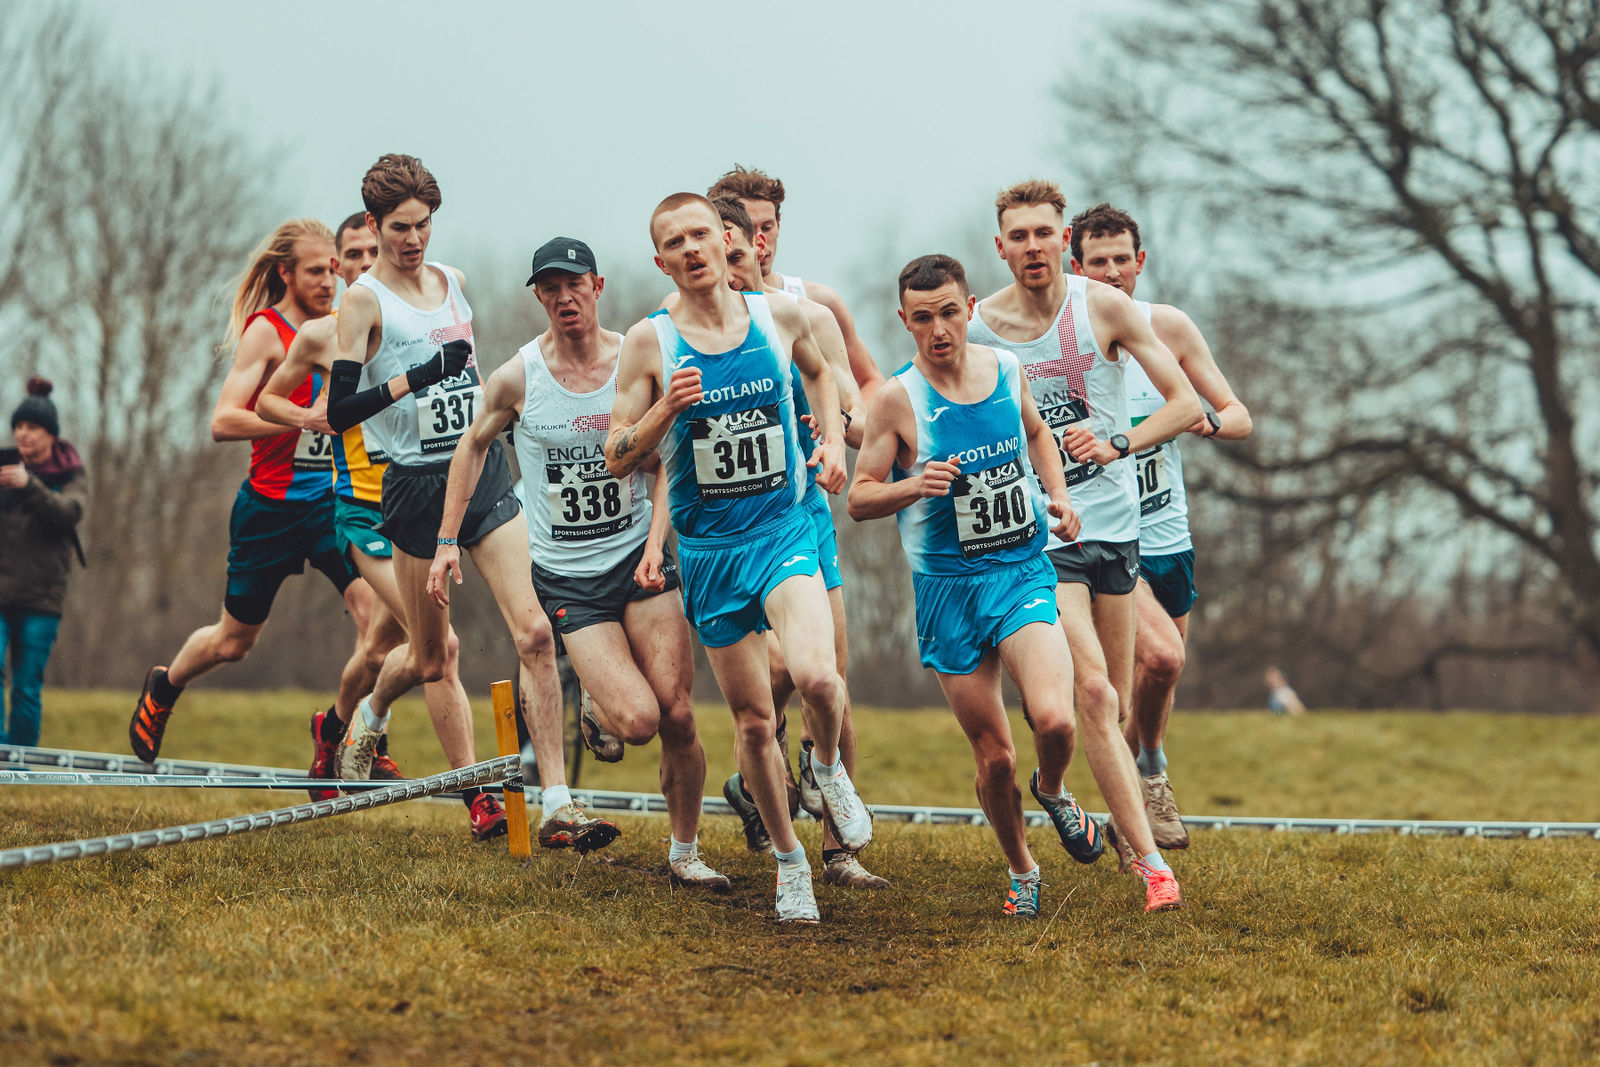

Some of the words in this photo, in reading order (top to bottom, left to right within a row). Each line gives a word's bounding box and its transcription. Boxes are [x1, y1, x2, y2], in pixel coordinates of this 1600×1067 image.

[431, 391, 474, 433] 337
[547, 444, 605, 461] ENGLA
[713, 433, 770, 480] 341
[580, 462, 608, 475] UK
[702, 483, 763, 495] SPORTSSHOES.COM
[561, 482, 621, 522] 338
[970, 485, 1026, 534] 340
[554, 526, 610, 536] SPORTSSHOES.COM
[963, 535, 1020, 552] SPORTSSHOES.COM
